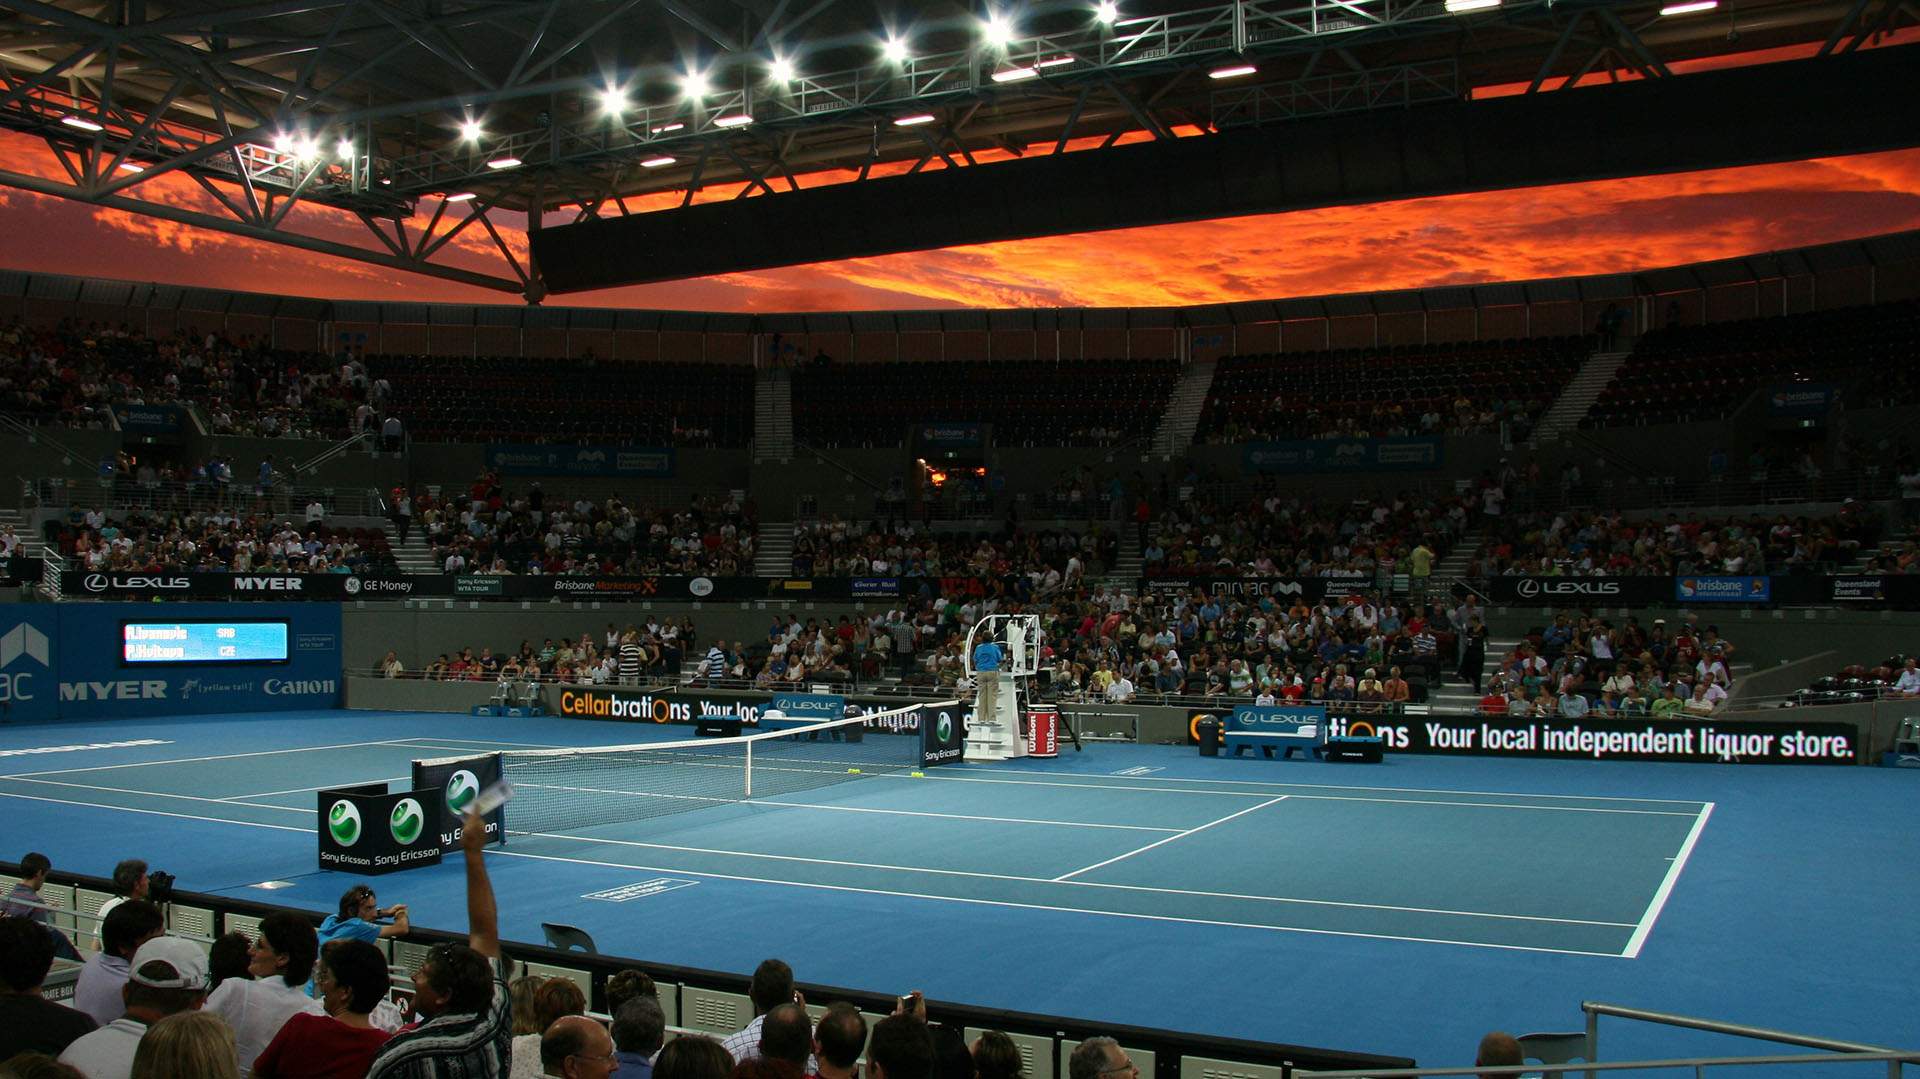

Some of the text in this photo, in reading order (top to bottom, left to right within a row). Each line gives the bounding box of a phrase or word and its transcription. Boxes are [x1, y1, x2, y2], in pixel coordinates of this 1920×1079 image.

[113, 577, 190, 588] LEXUS
[234, 577, 303, 590] MYER
[364, 580, 413, 592] GE Money
[554, 580, 595, 591] Brisbane
[1543, 582, 1621, 594] LEXUS
[1696, 579, 1743, 591] brisbane
[1834, 580, 1881, 588] Queensland
[60, 680, 168, 701] MYER
[263, 678, 336, 695] Canon
[1260, 713, 1320, 724] LEXUS
[1028, 715, 1037, 753] Wilson
[1046, 715, 1056, 753] Wilson
[1425, 723, 1477, 748] Your
[1482, 723, 1536, 751] local
[1543, 725, 1694, 757] independent
[1700, 728, 1774, 762] liquor
[1780, 730, 1854, 758] store.
[321, 851, 371, 866] Sony Ericsson
[374, 847, 440, 866] Sony Ericsson
